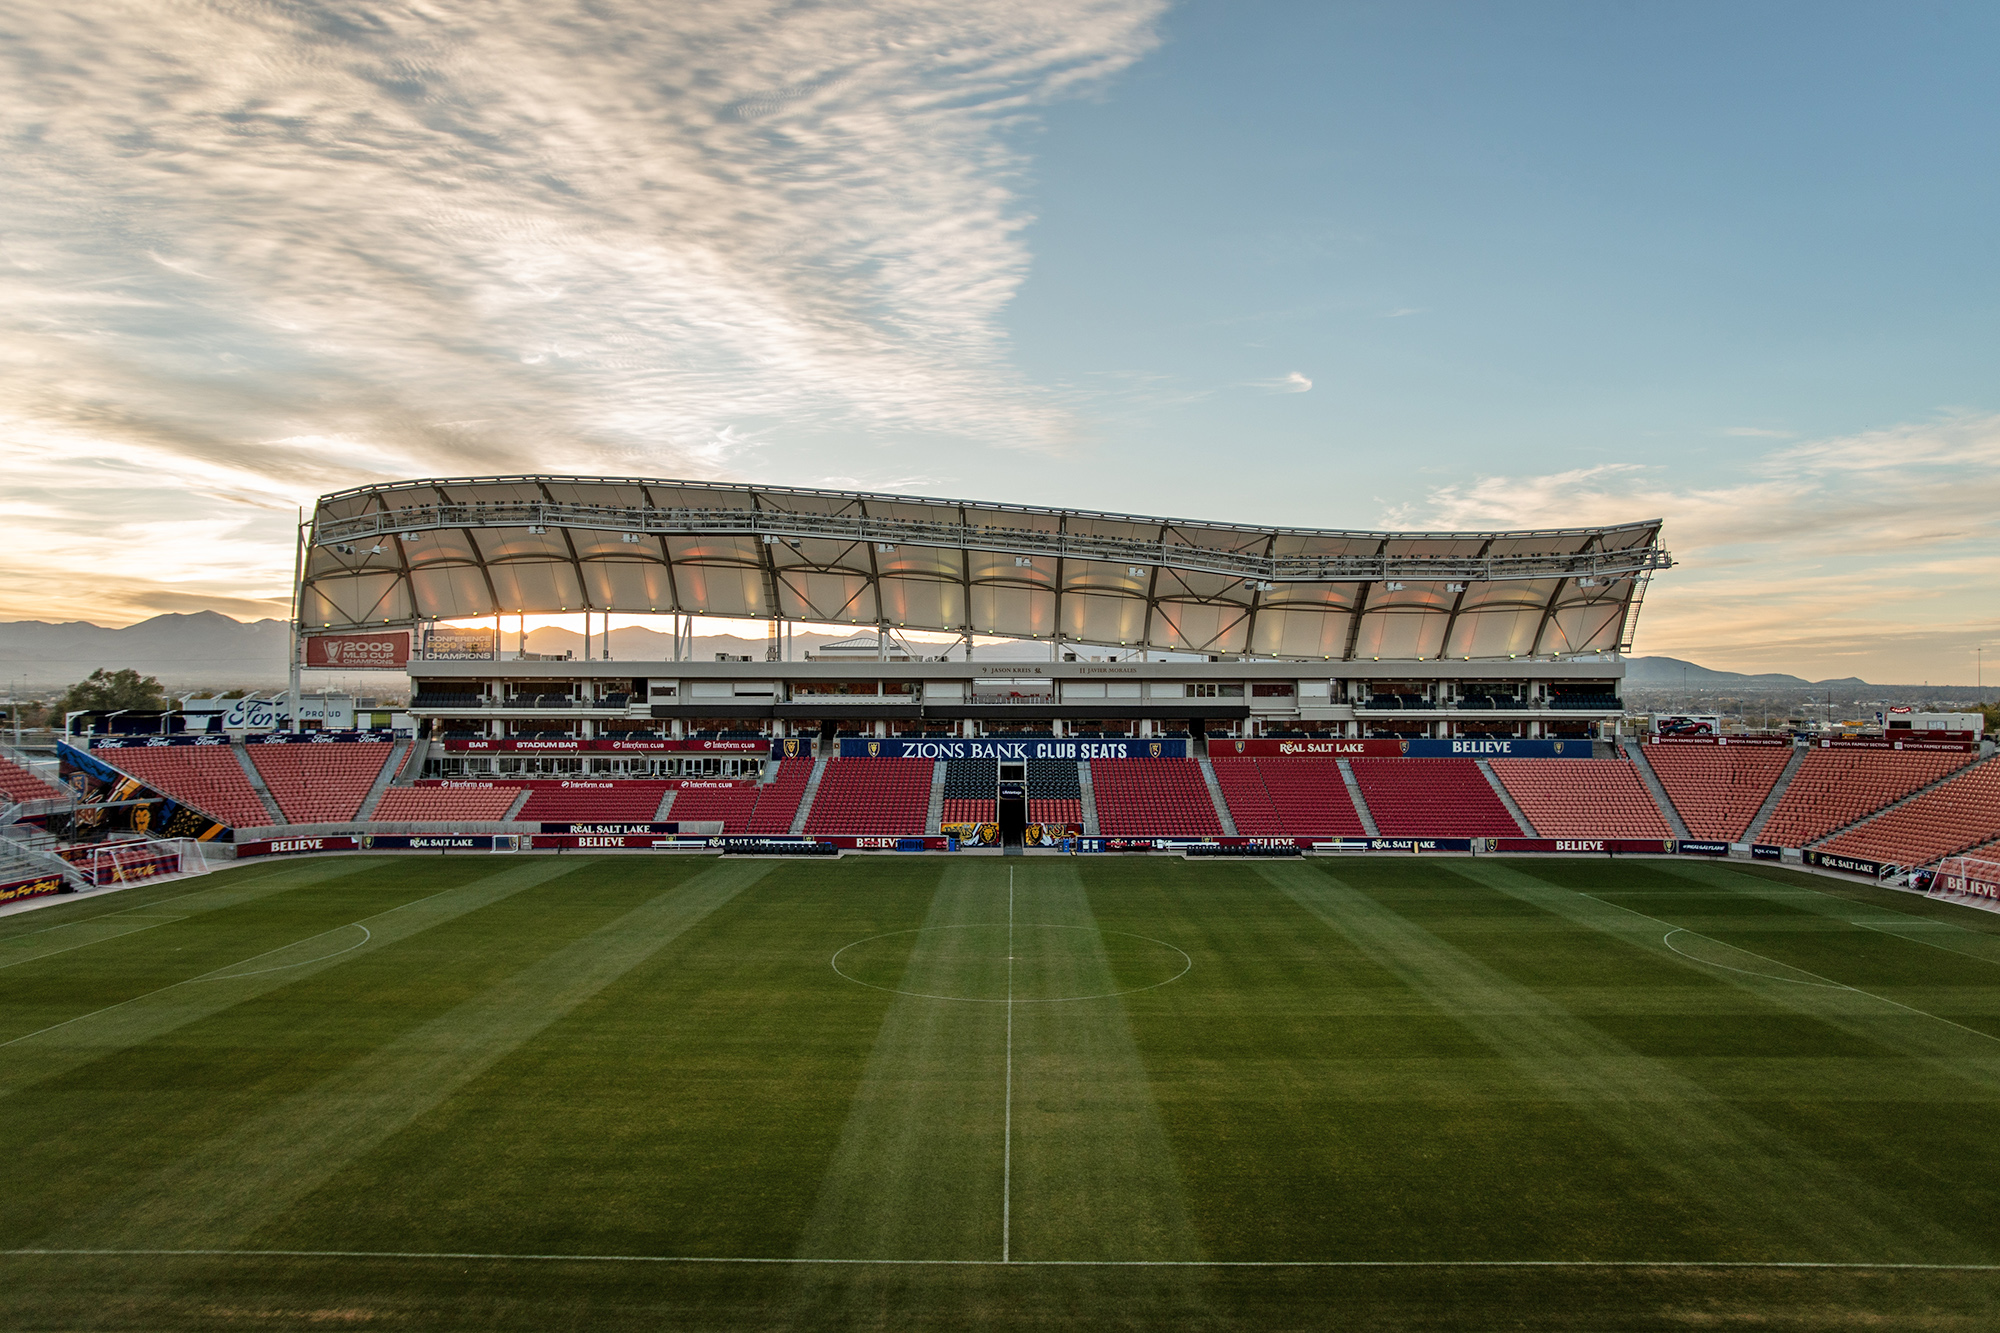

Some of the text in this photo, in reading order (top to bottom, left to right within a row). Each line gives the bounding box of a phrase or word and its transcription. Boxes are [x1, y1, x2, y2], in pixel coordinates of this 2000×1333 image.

[343, 642, 394, 652] 2009
[426, 652, 491, 660] CHAMPIONS
[146, 737, 171, 747] Ford
[195, 735, 220, 746] Ford
[264, 735, 288, 744] Ford
[311, 733, 335, 744] Ford
[358, 733, 382, 743] Ford
[98, 738, 122, 749] Ford
[1307, 743, 1334, 753] SALT
[1336, 743, 1365, 753] LAKE
[1452, 741, 1512, 753] BELIEVE
[902, 743, 1029, 759] ZIONS BANK
[1036, 743, 1127, 759] CLUB SEATS
[596, 825, 622, 834] SALT
[623, 825, 650, 834] LAKE
[271, 839, 323, 851] BELIEVE
[430, 838, 450, 847] SALT
[451, 838, 473, 847] LAKE
[578, 837, 625, 847] BELIEVE
[1392, 840, 1412, 848] SALT
[1556, 841, 1604, 851] BELIEVE
[1838, 859, 1855, 870] SALT
[1855, 863, 1873, 874] LAKE
[1947, 876, 1998, 897] BELIEVE
